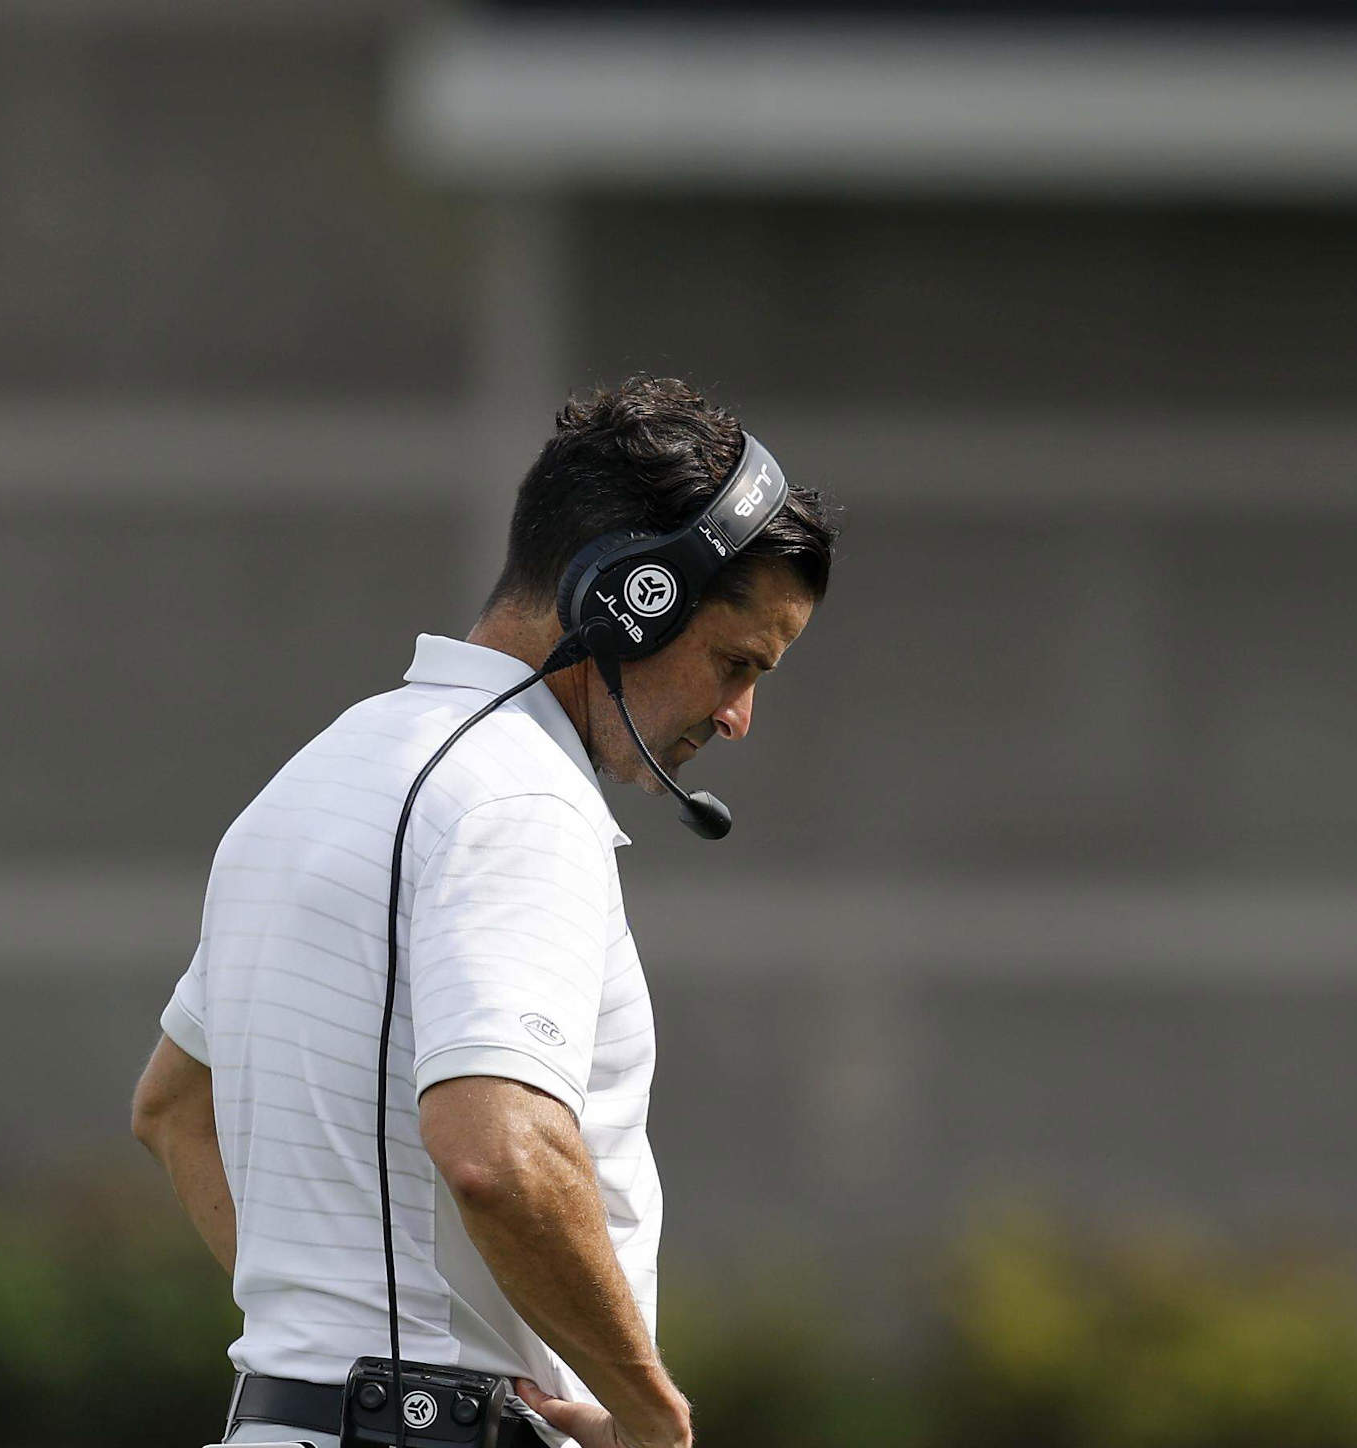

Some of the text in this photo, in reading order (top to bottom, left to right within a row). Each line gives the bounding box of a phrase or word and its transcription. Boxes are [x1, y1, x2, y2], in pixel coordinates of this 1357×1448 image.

[734, 463, 772, 517] JLAB
[698, 525, 726, 557] JLAB
[595, 590, 643, 643] JLAB
